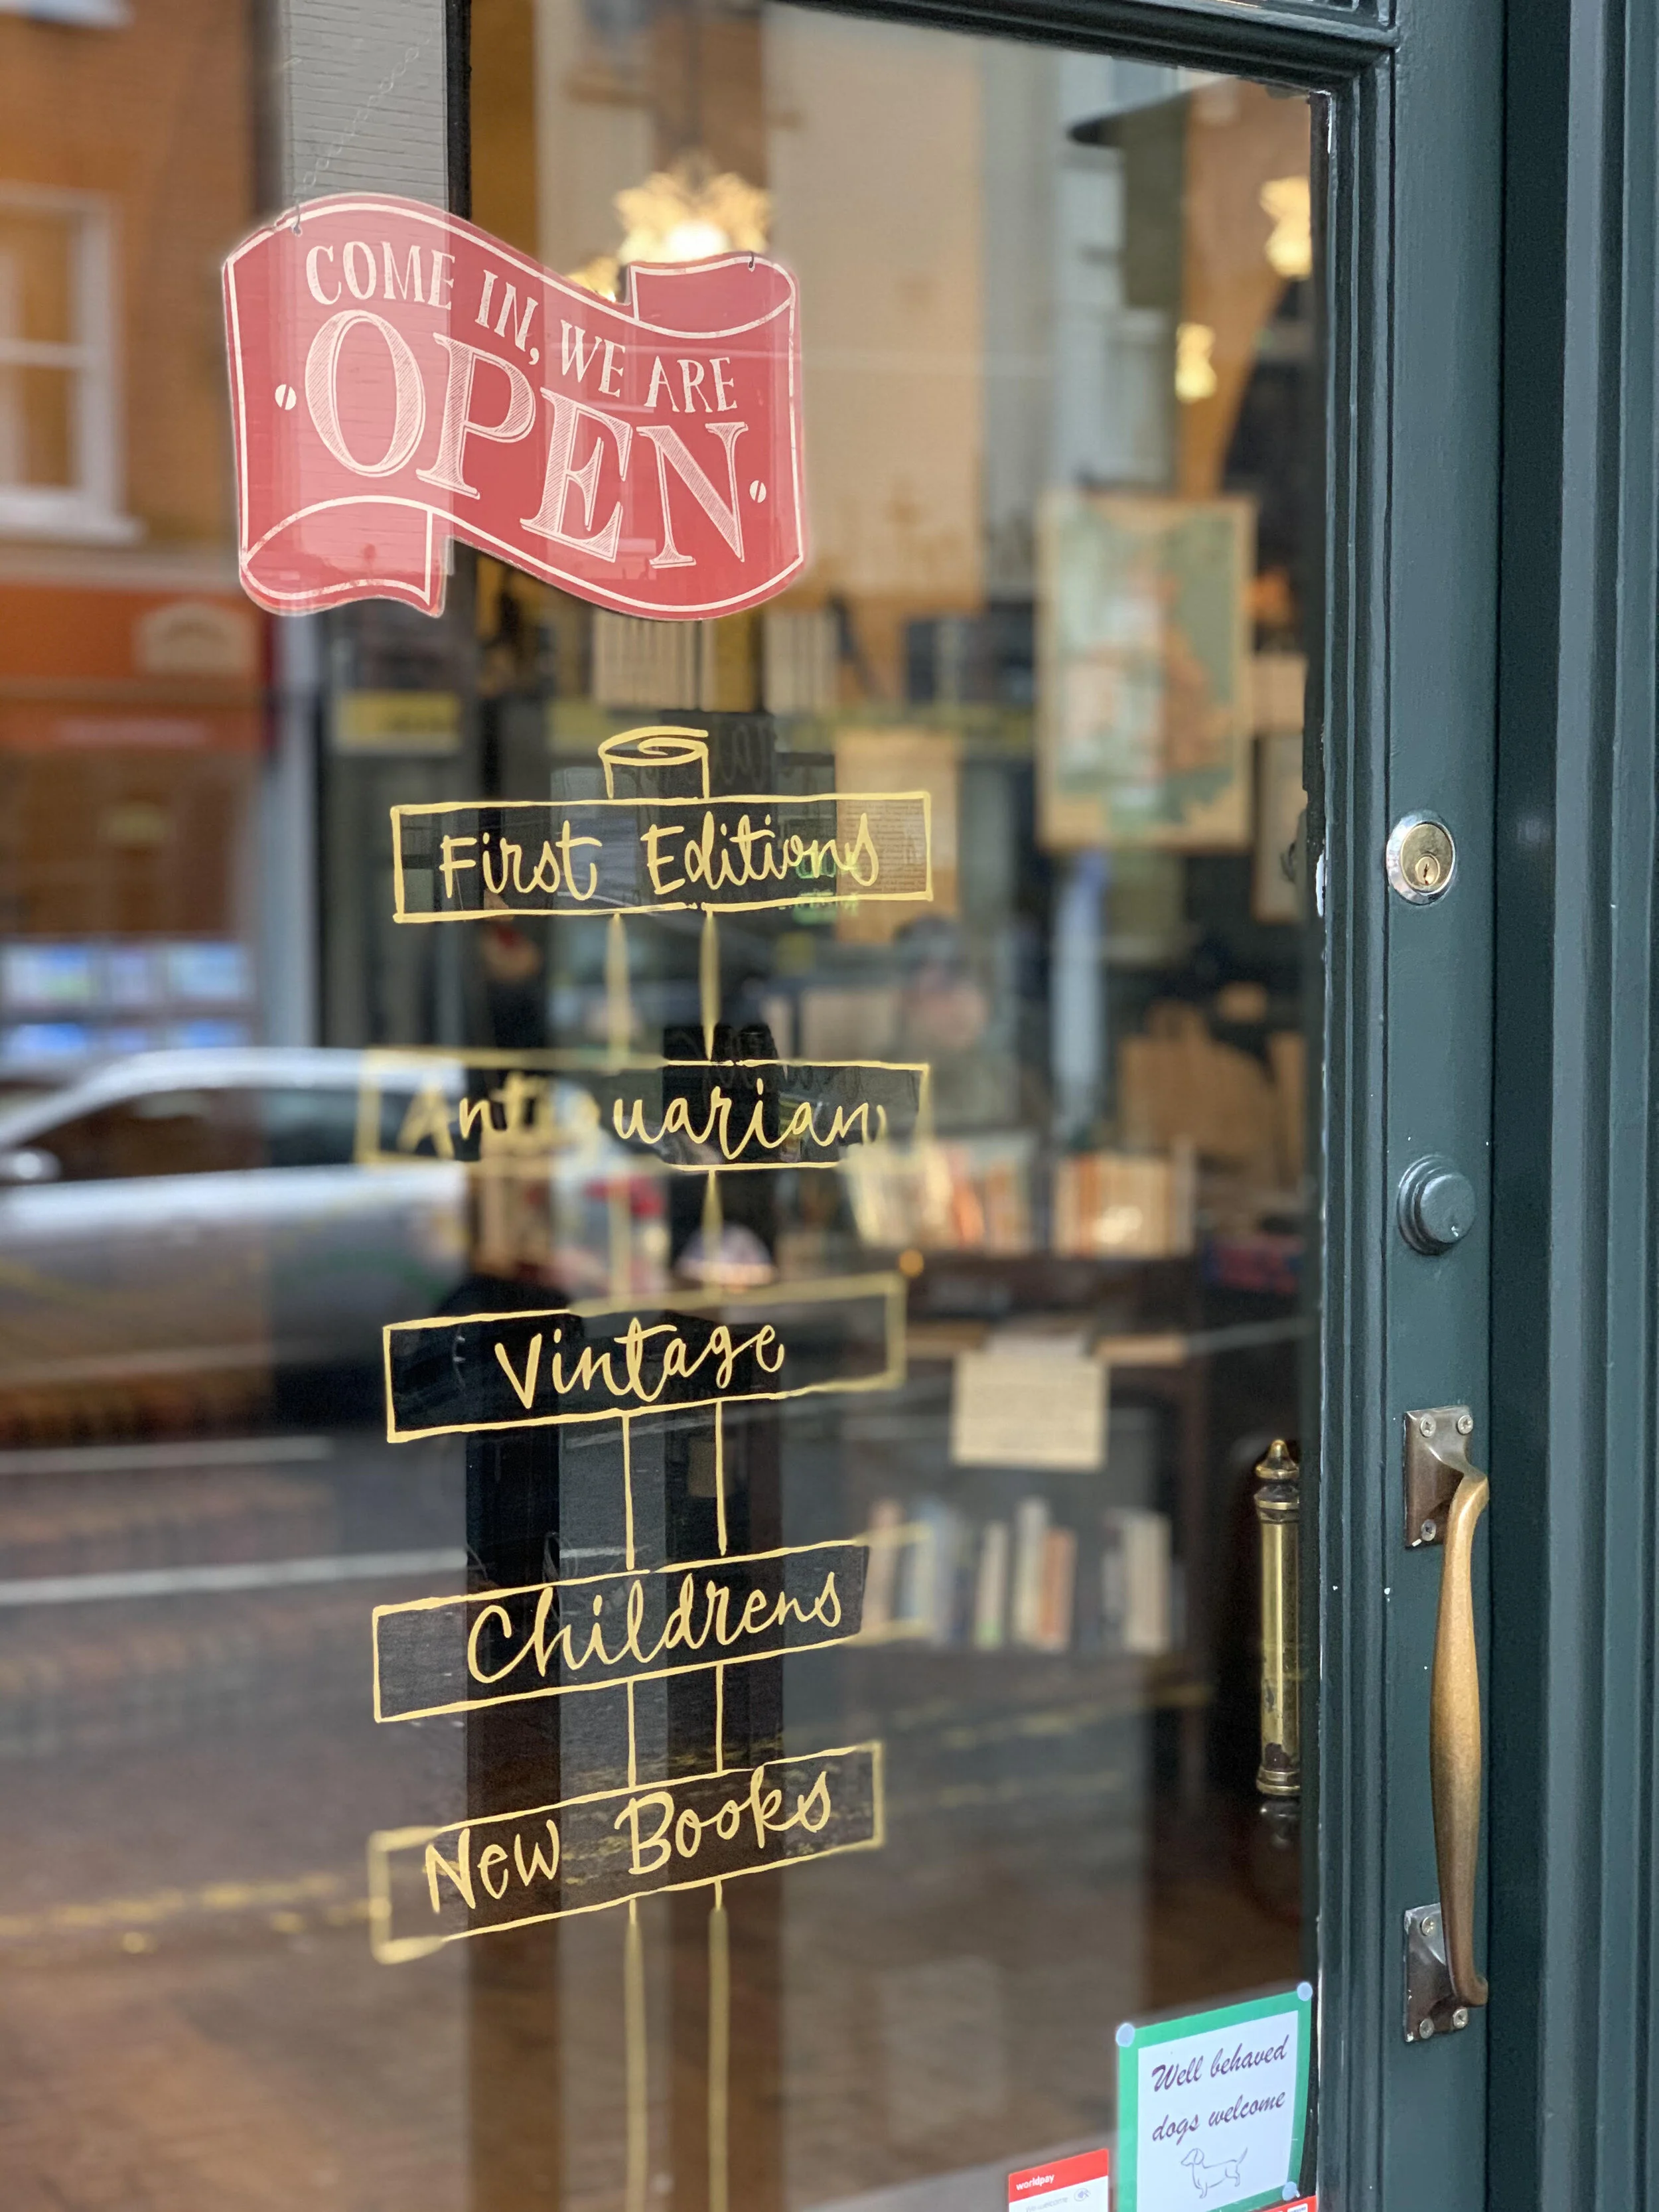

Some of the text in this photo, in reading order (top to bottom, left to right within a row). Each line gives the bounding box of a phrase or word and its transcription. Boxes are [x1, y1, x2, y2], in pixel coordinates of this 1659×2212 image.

[306, 240, 738, 414] COME IN, WE ARE
[304, 309, 750, 569] OPEN
[439, 820, 603, 900] First
[640, 811, 879, 895] Editions
[400, 1072, 888, 1160] Antuarian
[494, 1317, 786, 1408] Vintage
[467, 1572, 842, 1684] Childrens
[425, 1762, 832, 1913] New Books
[1151, 2034, 1289, 2092] Well behaved
[1152, 2091, 1285, 2146] dogs welcome
[1016, 2174, 1054, 2191] worldpay
